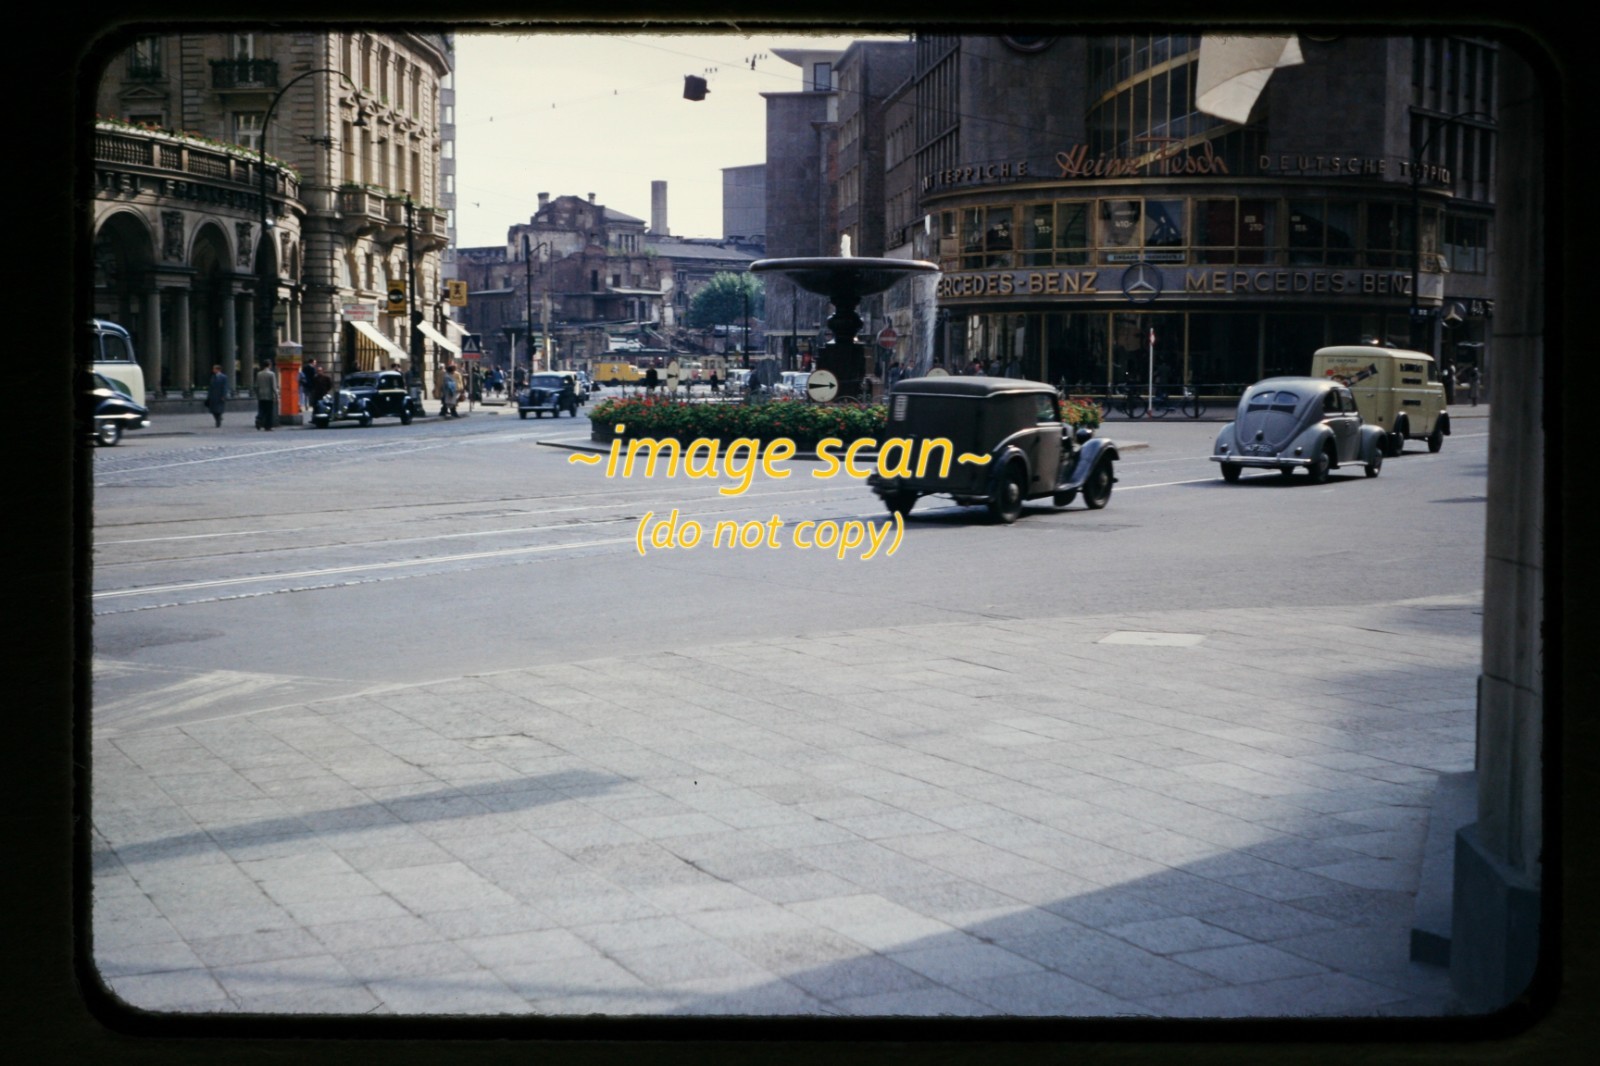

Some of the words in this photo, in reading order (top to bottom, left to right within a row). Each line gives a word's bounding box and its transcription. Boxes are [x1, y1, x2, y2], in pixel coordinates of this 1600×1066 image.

[1055, 143, 1141, 178] Heinz
[1259, 154, 1387, 174] DEUTSCHE
[938, 161, 1029, 185] TEPPICHE
[937, 271, 1099, 298] ERCEDES-BENZ
[1184, 271, 1413, 295] MERCEDES-BENZ
